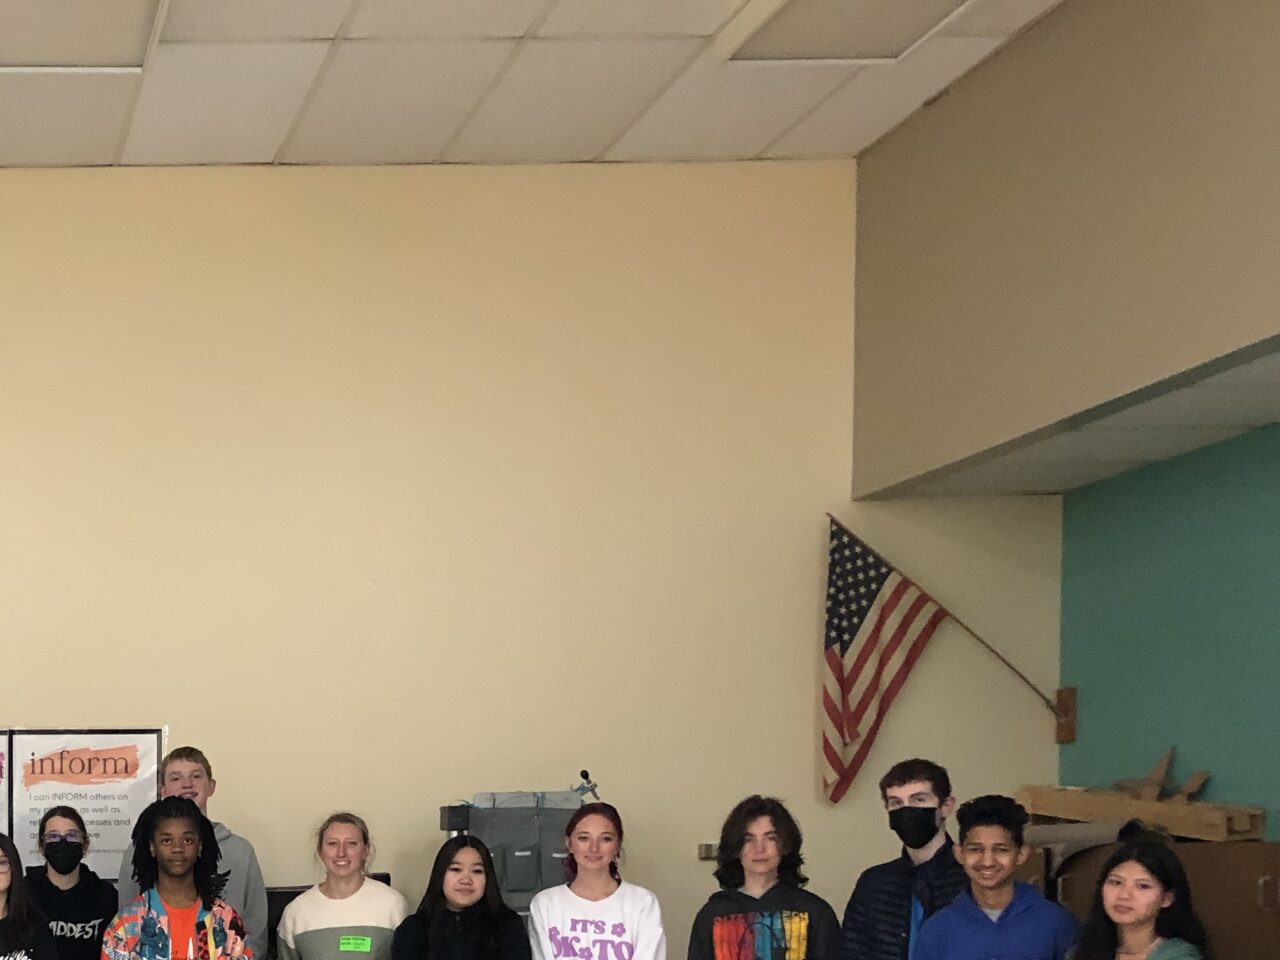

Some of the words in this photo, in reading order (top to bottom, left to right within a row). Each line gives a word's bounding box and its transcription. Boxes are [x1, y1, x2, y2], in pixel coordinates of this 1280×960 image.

[30, 750, 129, 775] inform
[114, 818, 131, 826] and
[570, 918, 606, 934] IT'S
